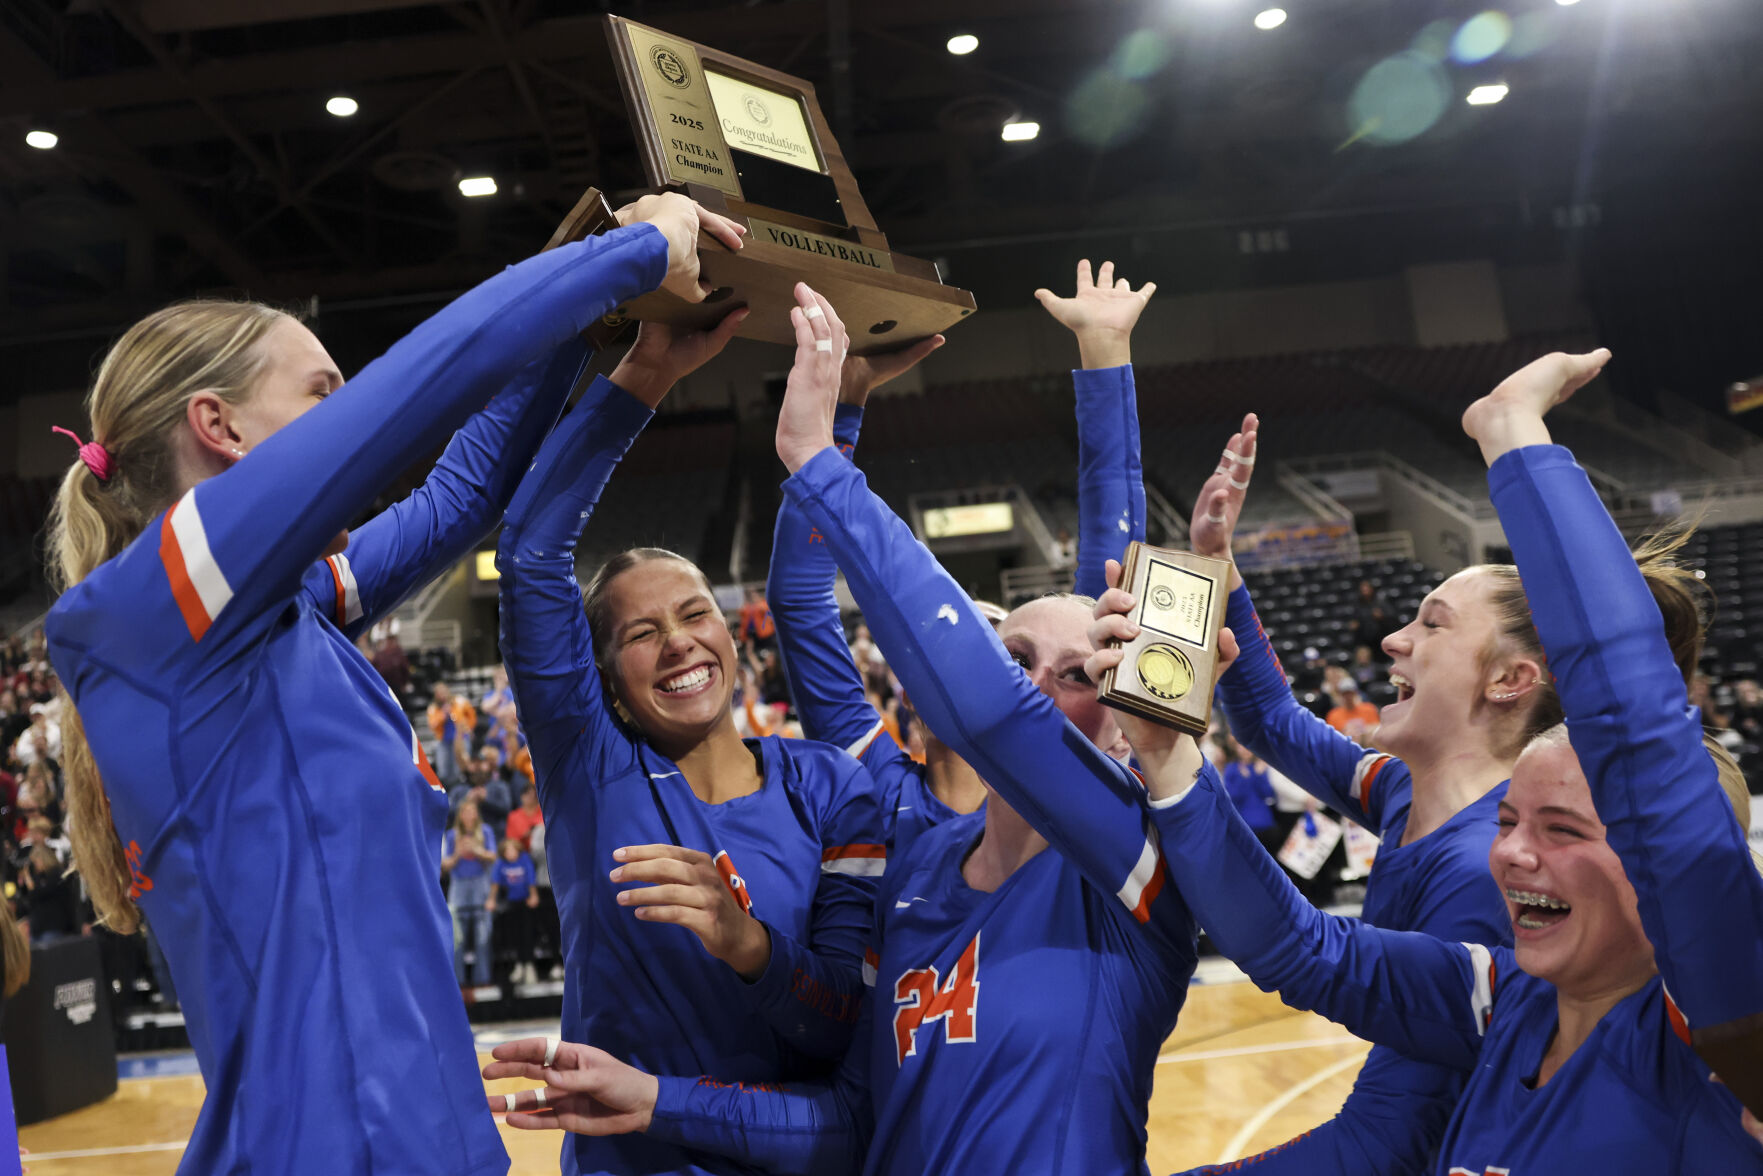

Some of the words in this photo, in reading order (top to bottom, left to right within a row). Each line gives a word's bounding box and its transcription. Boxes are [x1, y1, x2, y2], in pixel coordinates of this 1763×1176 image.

[670, 113, 704, 131] 2025
[722, 118, 808, 155] Congratulations
[671, 138, 704, 157] STATE
[705, 148, 719, 161] AA
[676, 154, 724, 175] Champion
[767, 227, 881, 269] VOLLEYBALL
[1193, 593, 1205, 628] Champion
[893, 929, 982, 1069] 24
